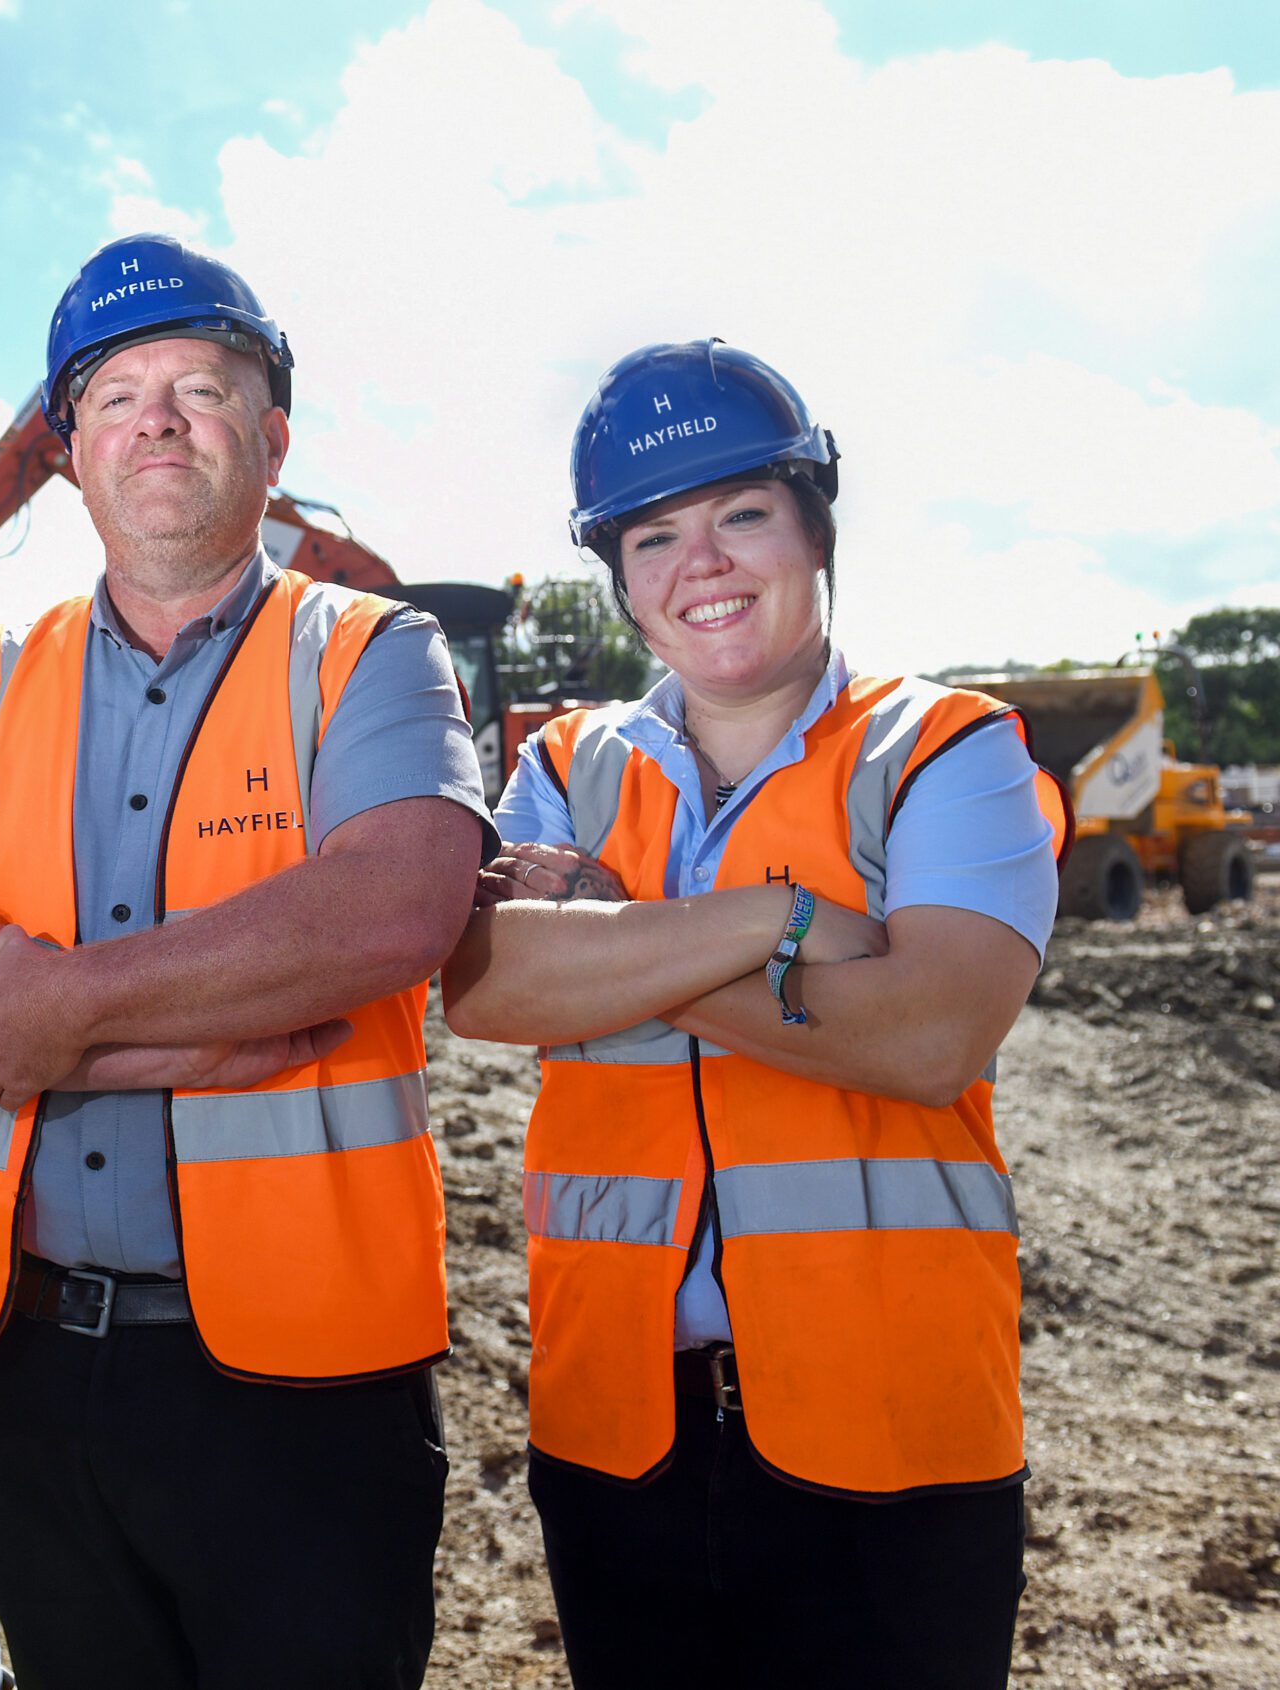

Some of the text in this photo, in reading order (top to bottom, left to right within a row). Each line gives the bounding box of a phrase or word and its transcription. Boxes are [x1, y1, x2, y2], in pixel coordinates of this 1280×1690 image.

[121, 258, 139, 275] H
[91, 278, 184, 312] HAYFIELD
[653, 393, 672, 414] H
[629, 417, 717, 456] HAYFIELD
[246, 767, 268, 792] H
